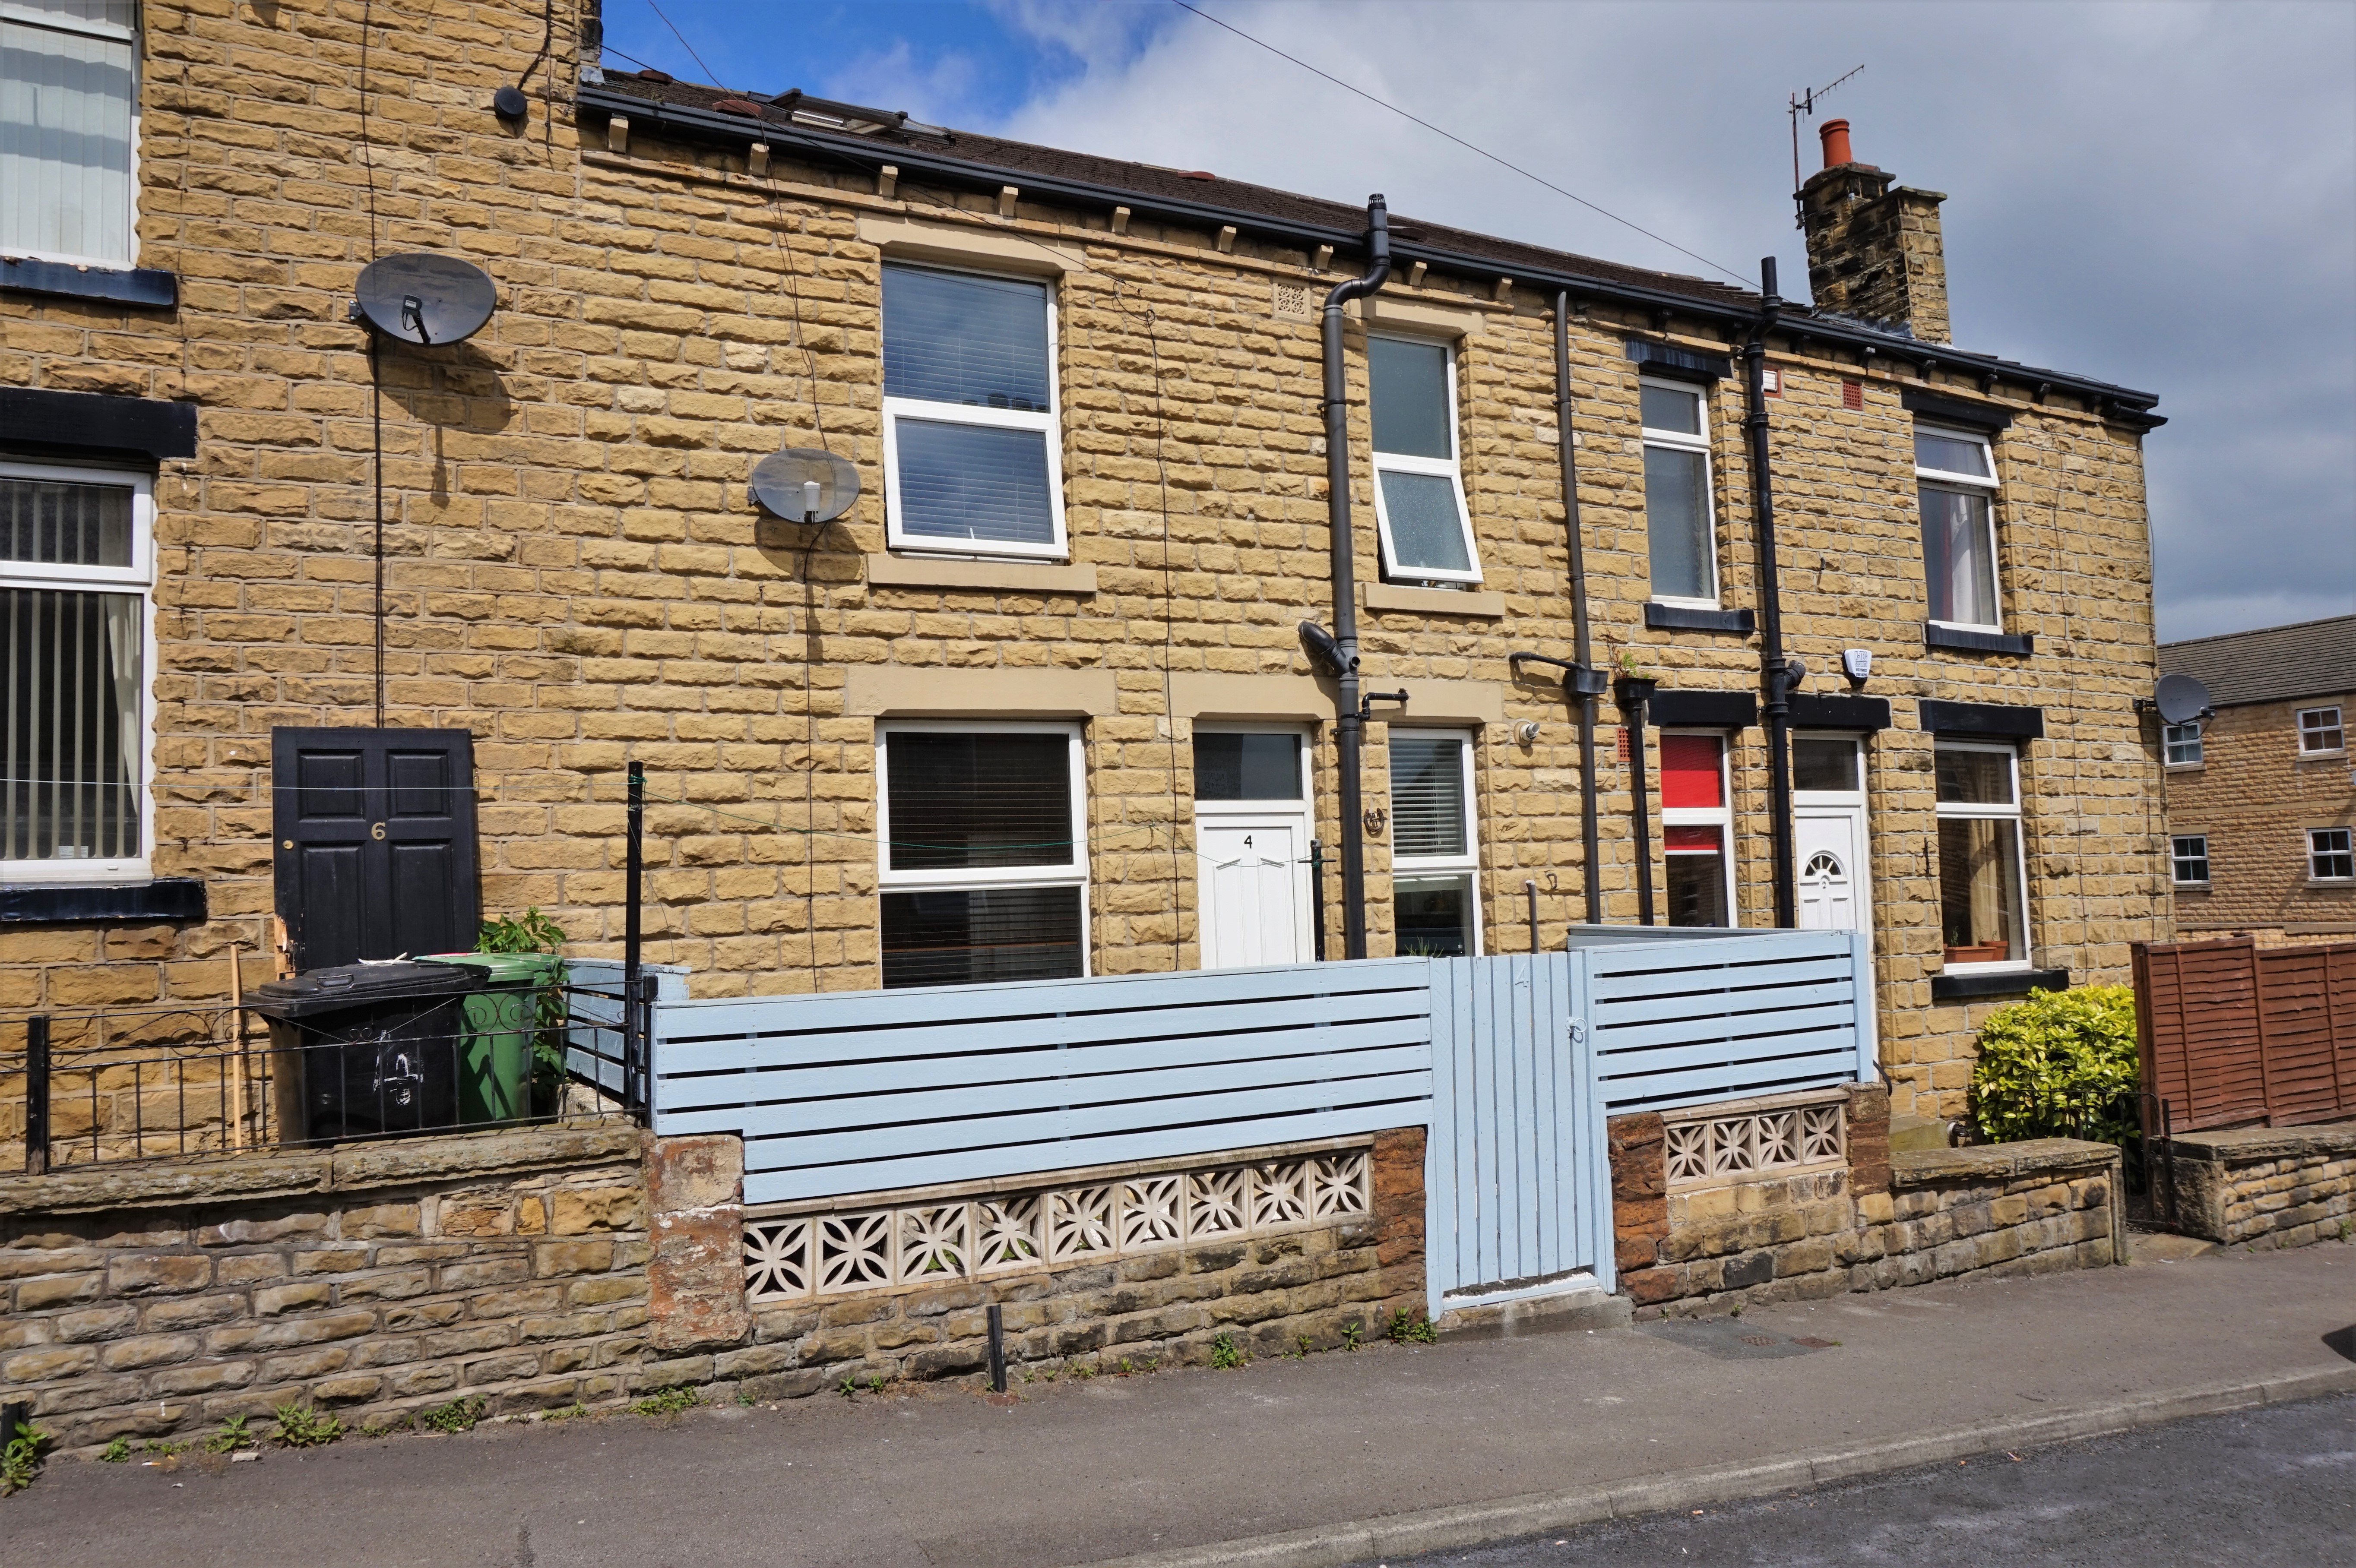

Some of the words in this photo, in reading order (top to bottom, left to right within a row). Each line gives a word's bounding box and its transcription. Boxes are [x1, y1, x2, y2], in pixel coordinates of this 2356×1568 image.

[372, 822, 386, 841] 6
[1244, 835, 1252, 849] 4
[1515, 963, 1529, 988] 4
